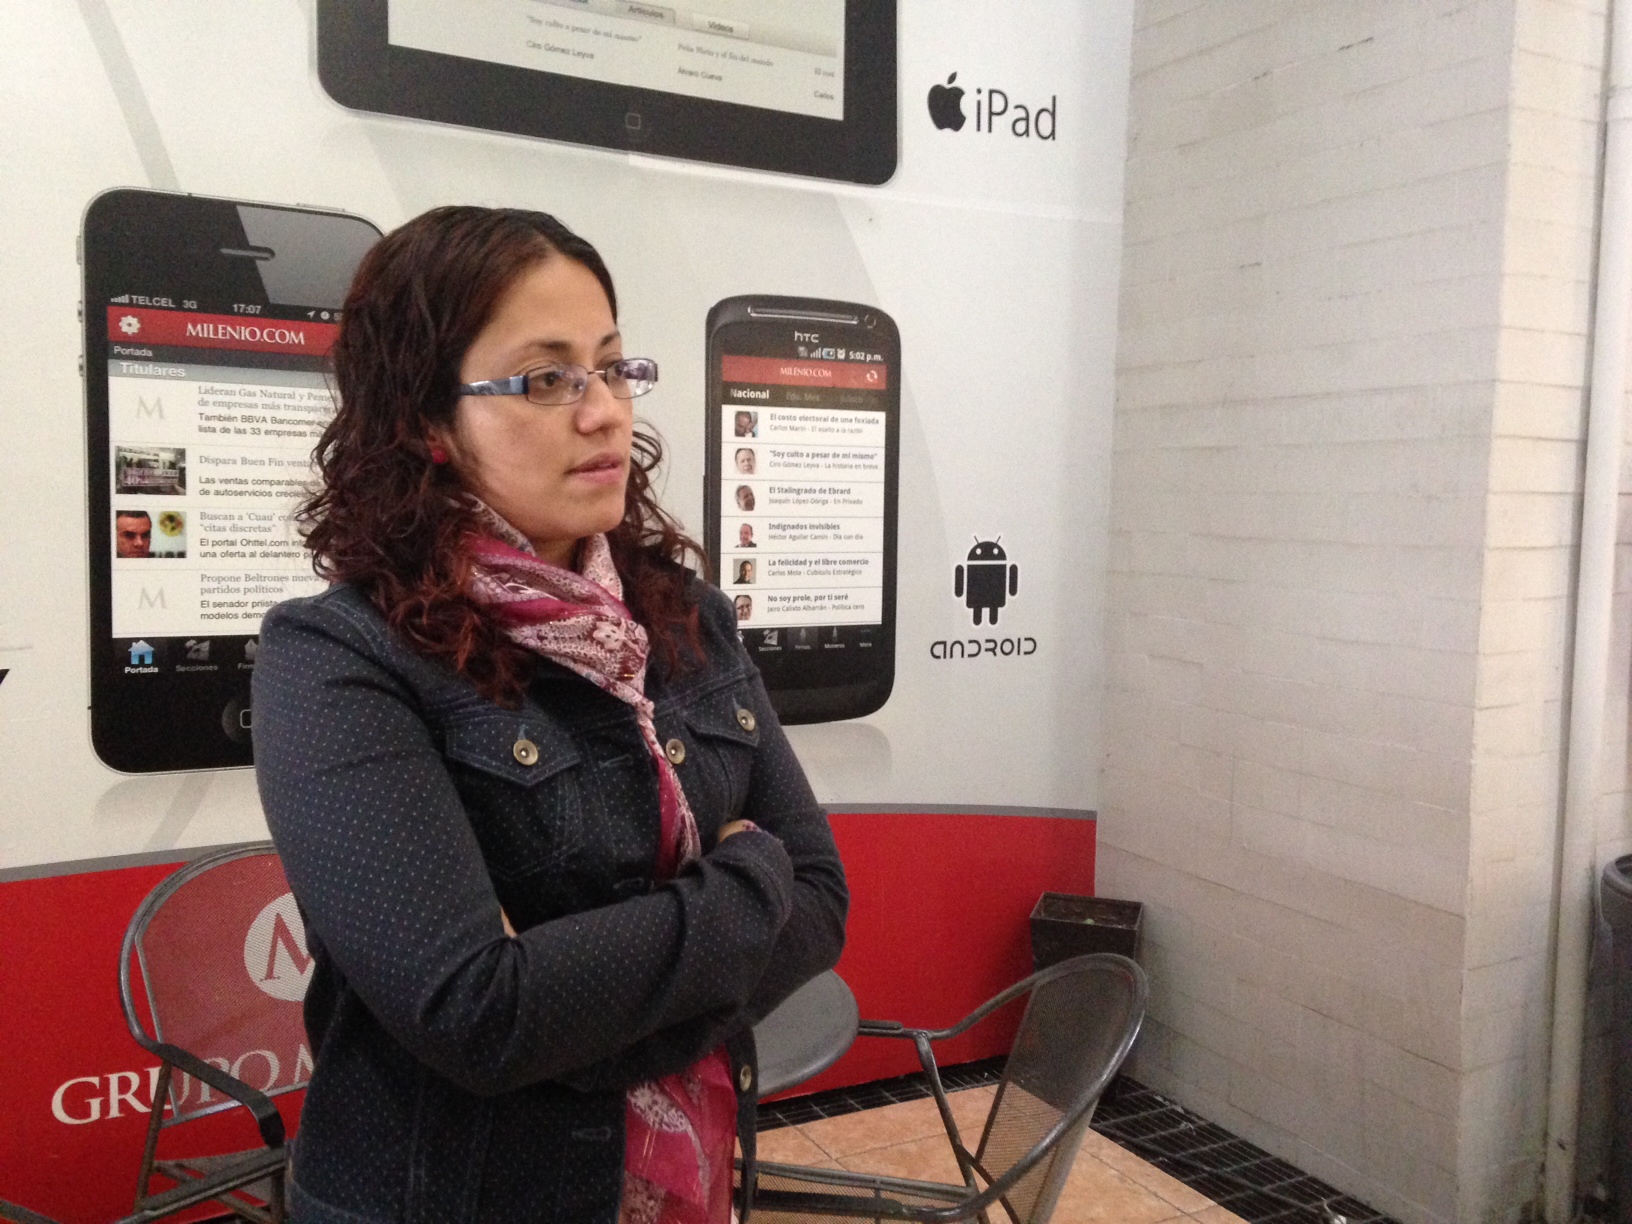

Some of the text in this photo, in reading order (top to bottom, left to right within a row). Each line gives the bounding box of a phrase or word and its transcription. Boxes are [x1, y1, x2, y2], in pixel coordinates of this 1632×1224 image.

[976, 88, 1056, 141] iPad
[131, 295, 262, 315] TELCEL 3G 17:07
[185, 321, 306, 346] MILENIO.COM
[113, 345, 153, 357] Portada
[849, 350, 866, 361] 5:02
[120, 360, 187, 378] Titulares
[779, 366, 833, 379] MILENIO.COM
[198, 385, 237, 398] Lideran
[238, 387, 258, 399] Gas
[259, 389, 296, 401] Natural
[730, 388, 770, 400] Nacional
[197, 398, 208, 408] de
[210, 399, 259, 413] empresas
[261, 402, 281, 412] más
[199, 412, 238, 424] También
[240, 413, 268, 425] BBVA
[770, 413, 777, 421] El
[778, 414, 798, 422] costo
[799, 413, 830, 423] electoral
[831, 416, 840, 424] de
[198, 424, 307, 438] lista de las 33 empresas
[199, 455, 284, 468] Dispara Buen Fin
[811, 453, 831, 461] pesar
[831, 450, 841, 459] de
[199, 475, 216, 486] Las
[218, 477, 249, 487] ventas
[199, 488, 273, 499] de autoservicios
[768, 486, 776, 494] El
[777, 486, 817, 496] Stalingrado
[818, 486, 828, 495] de
[199, 511, 234, 522] Buscan
[768, 522, 841, 532] Indignados invisibles
[199, 537, 208, 548] El
[211, 538, 238, 549] portal
[199, 549, 301, 559] una oferta al delantero
[768, 558, 777, 567] La
[777, 557, 807, 567] felicidad
[838, 557, 869, 566] comercio
[200, 573, 242, 586] Propone
[244, 573, 290, 583] Beltrones
[200, 585, 284, 597] partidos políticos
[200, 600, 210, 610] El
[212, 600, 249, 610] senador
[767, 593, 778, 603] No
[779, 595, 792, 605] soy
[814, 595, 827, 604] por
[200, 610, 239, 621] modelos
[124, 666, 159, 675] Portada
